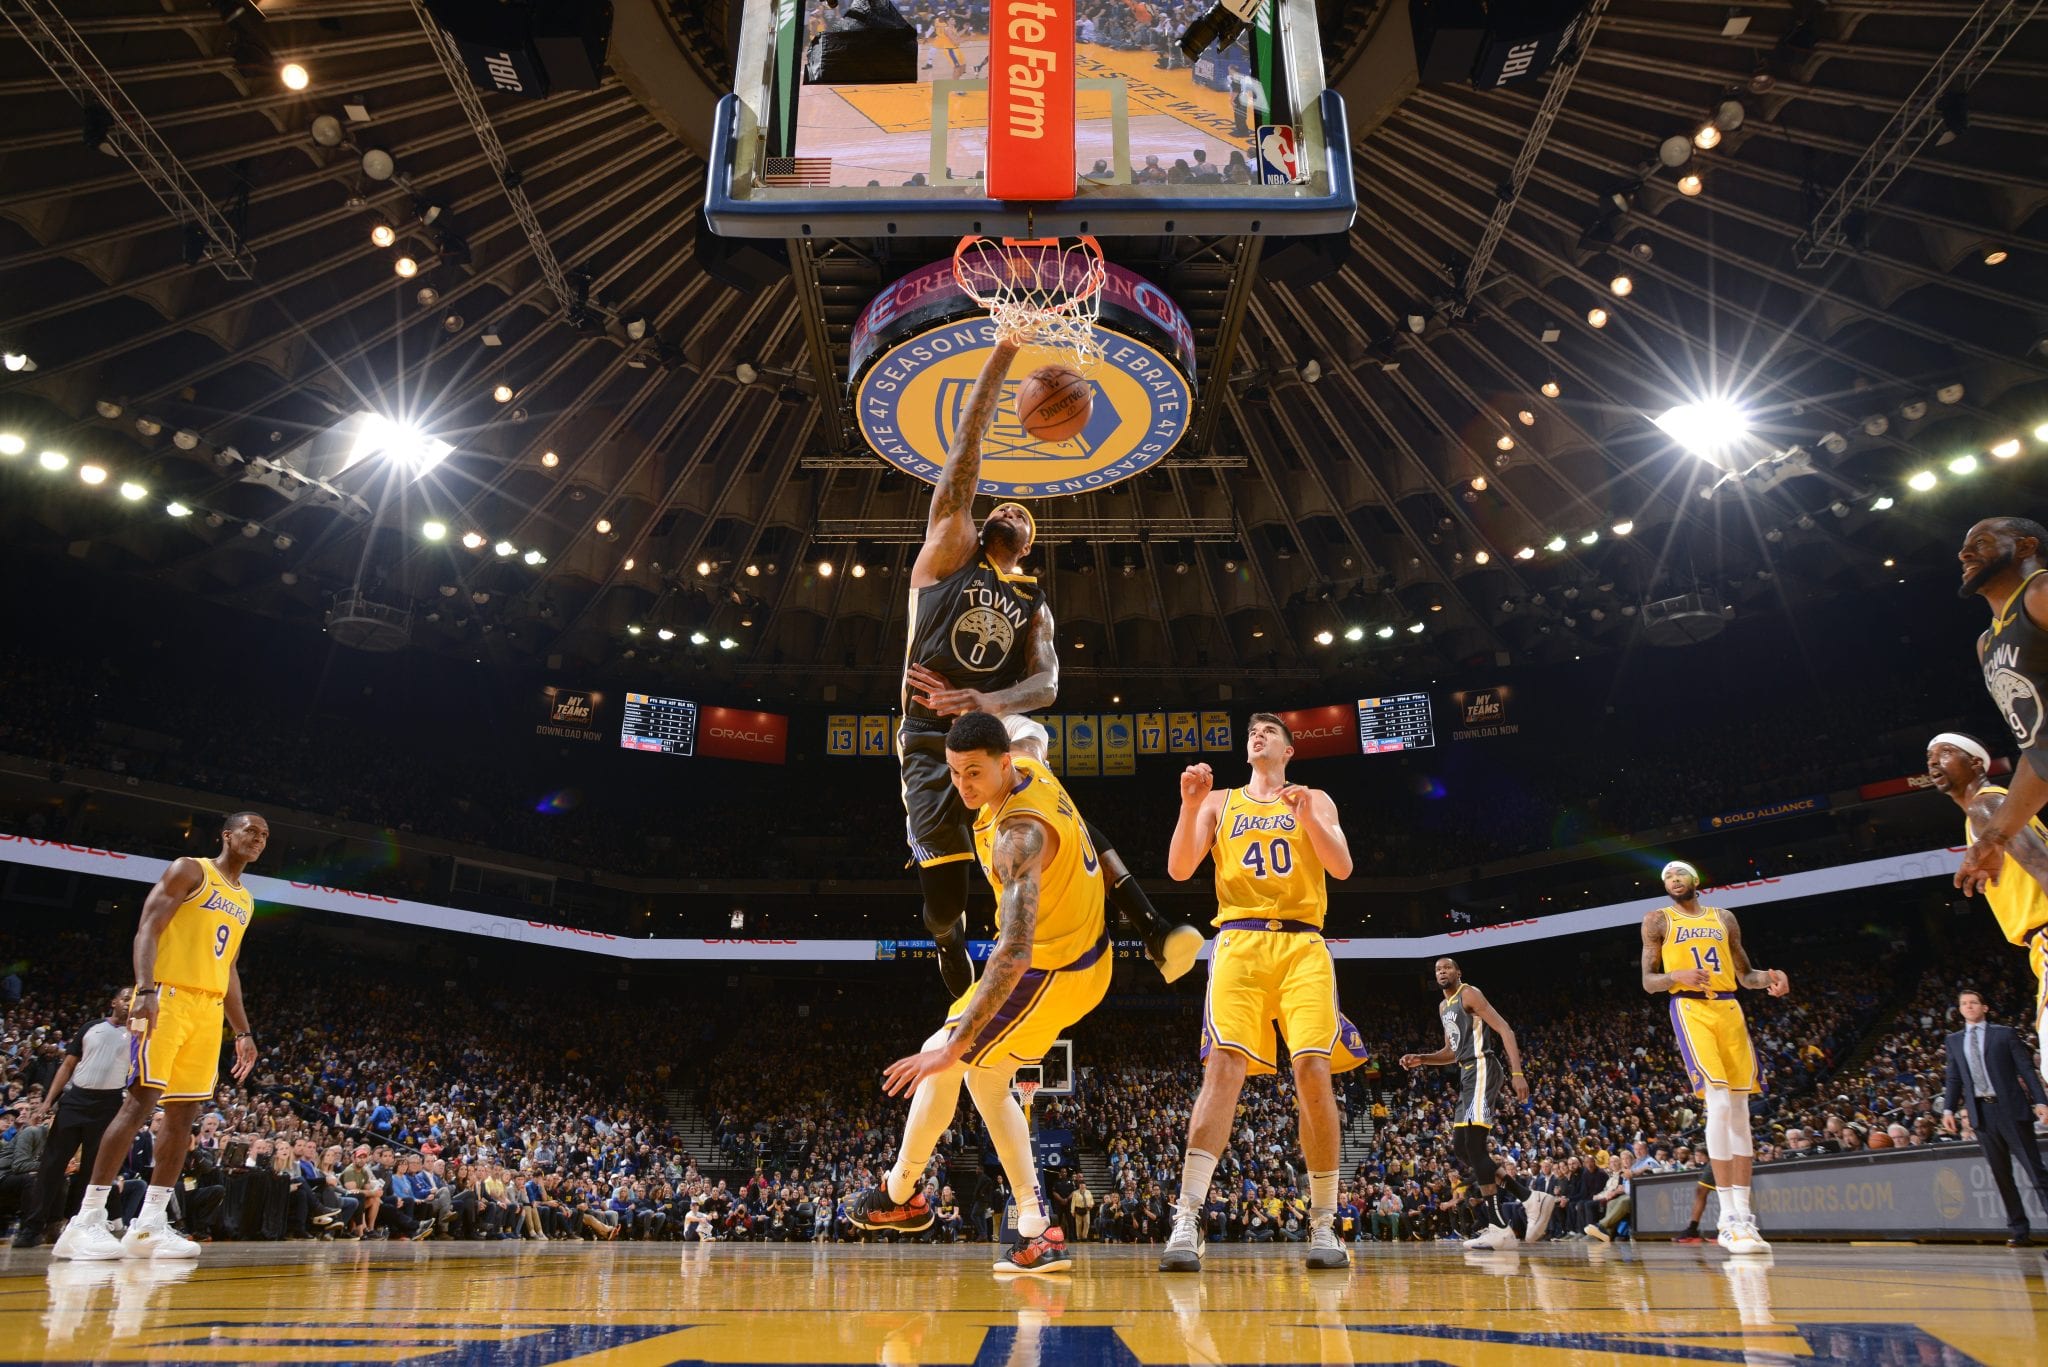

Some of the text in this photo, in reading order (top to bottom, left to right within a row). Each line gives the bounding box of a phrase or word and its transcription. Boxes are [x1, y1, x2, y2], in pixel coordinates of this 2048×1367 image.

[484, 52, 523, 92] JBL
[1496, 43, 1538, 86] JBL
[876, 326, 997, 392] SEASONS
[868, 397, 890, 419] 47
[1157, 420, 1177, 438] 47
[1045, 443, 1163, 493] SEASONS
[964, 588, 1028, 630] TOWN
[970, 642, 986, 665] 0
[567, 696, 584, 706] MY
[1467, 703, 1499, 715] TEAMS
[1476, 694, 1491, 705] MY
[557, 704, 590, 717] TEAMS
[536, 725, 602, 741] DOWNLOAD NOW
[709, 727, 776, 744] ORACLE
[1292, 726, 1344, 740] RACLE
[1453, 724, 1519, 741] DOWNLOAD NOW
[2009, 712, 2028, 739] 9
[831, 730, 852, 750] 13
[864, 730, 884, 750] 14
[1141, 728, 1161, 749] 17
[1171, 727, 1196, 748] 24
[1205, 726, 1230, 747] 42
[1724, 800, 1815, 825] GOLD ALLIANCE
[1229, 813, 1296, 839] LAKERS
[1242, 838, 1292, 877] 40
[200, 889, 247, 925] LAKERS
[215, 924, 230, 957] 9
[1674, 926, 1723, 944] LAKERS
[901, 950, 907, 958] 5
[913, 950, 923, 958] 19
[1690, 946, 1721, 972] 14
